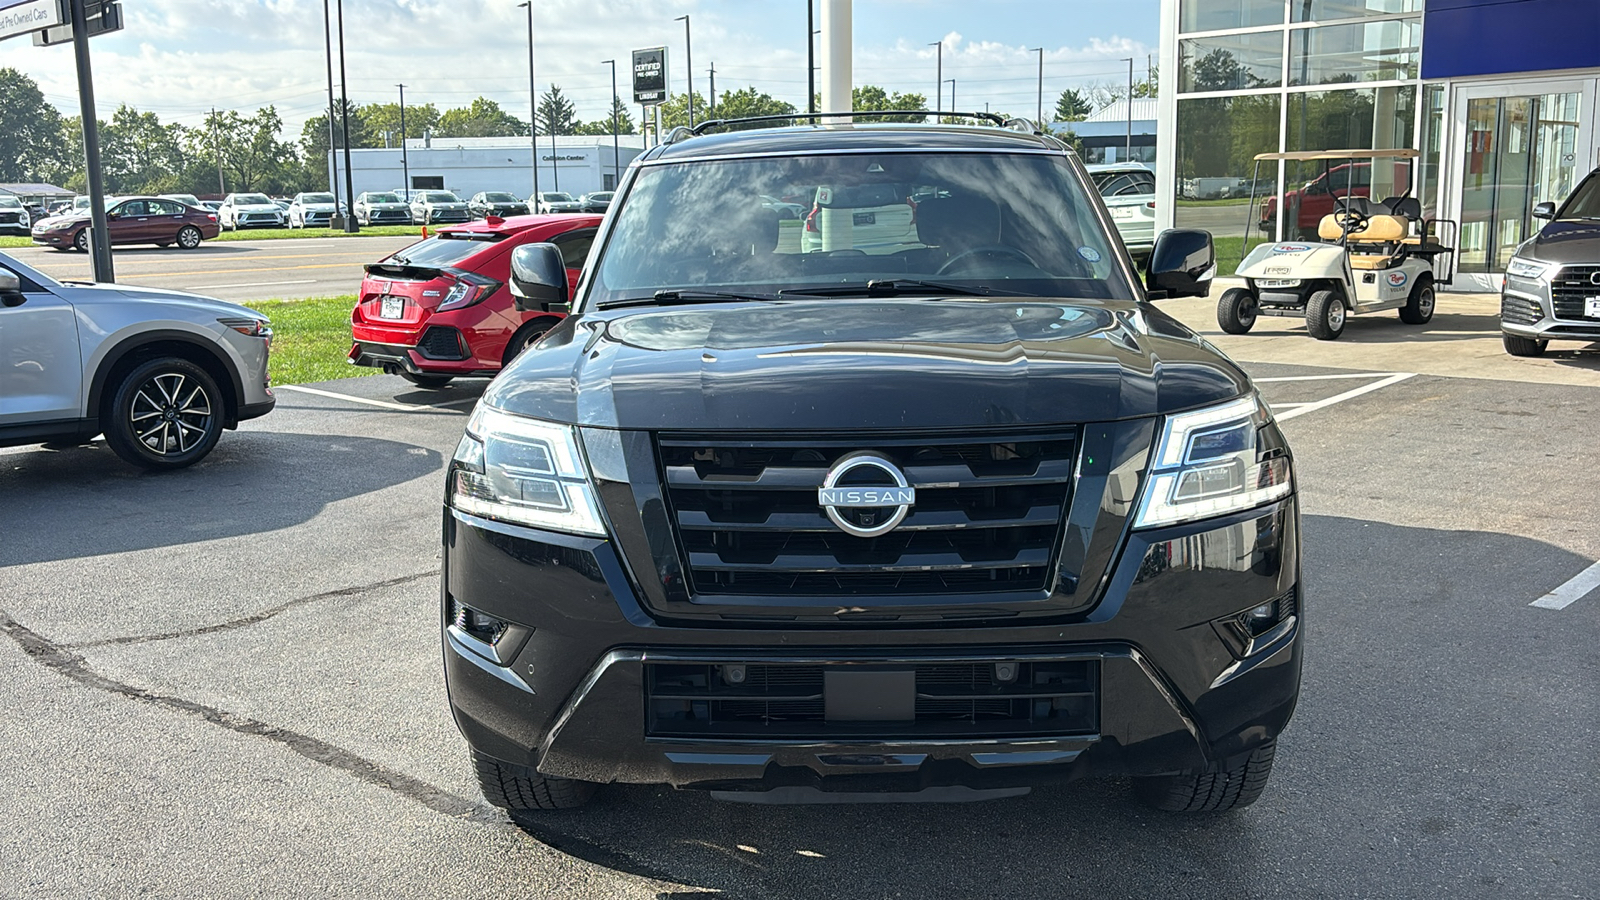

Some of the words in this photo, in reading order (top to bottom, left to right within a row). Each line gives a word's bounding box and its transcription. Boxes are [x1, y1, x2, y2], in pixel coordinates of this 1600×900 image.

[5, 16, 14, 28] Pre
[14, 10, 32, 26] Owned
[33, 8, 48, 21] Cars
[635, 62, 661, 72] CERTIFIED
[822, 491, 913, 504] NISSAN
